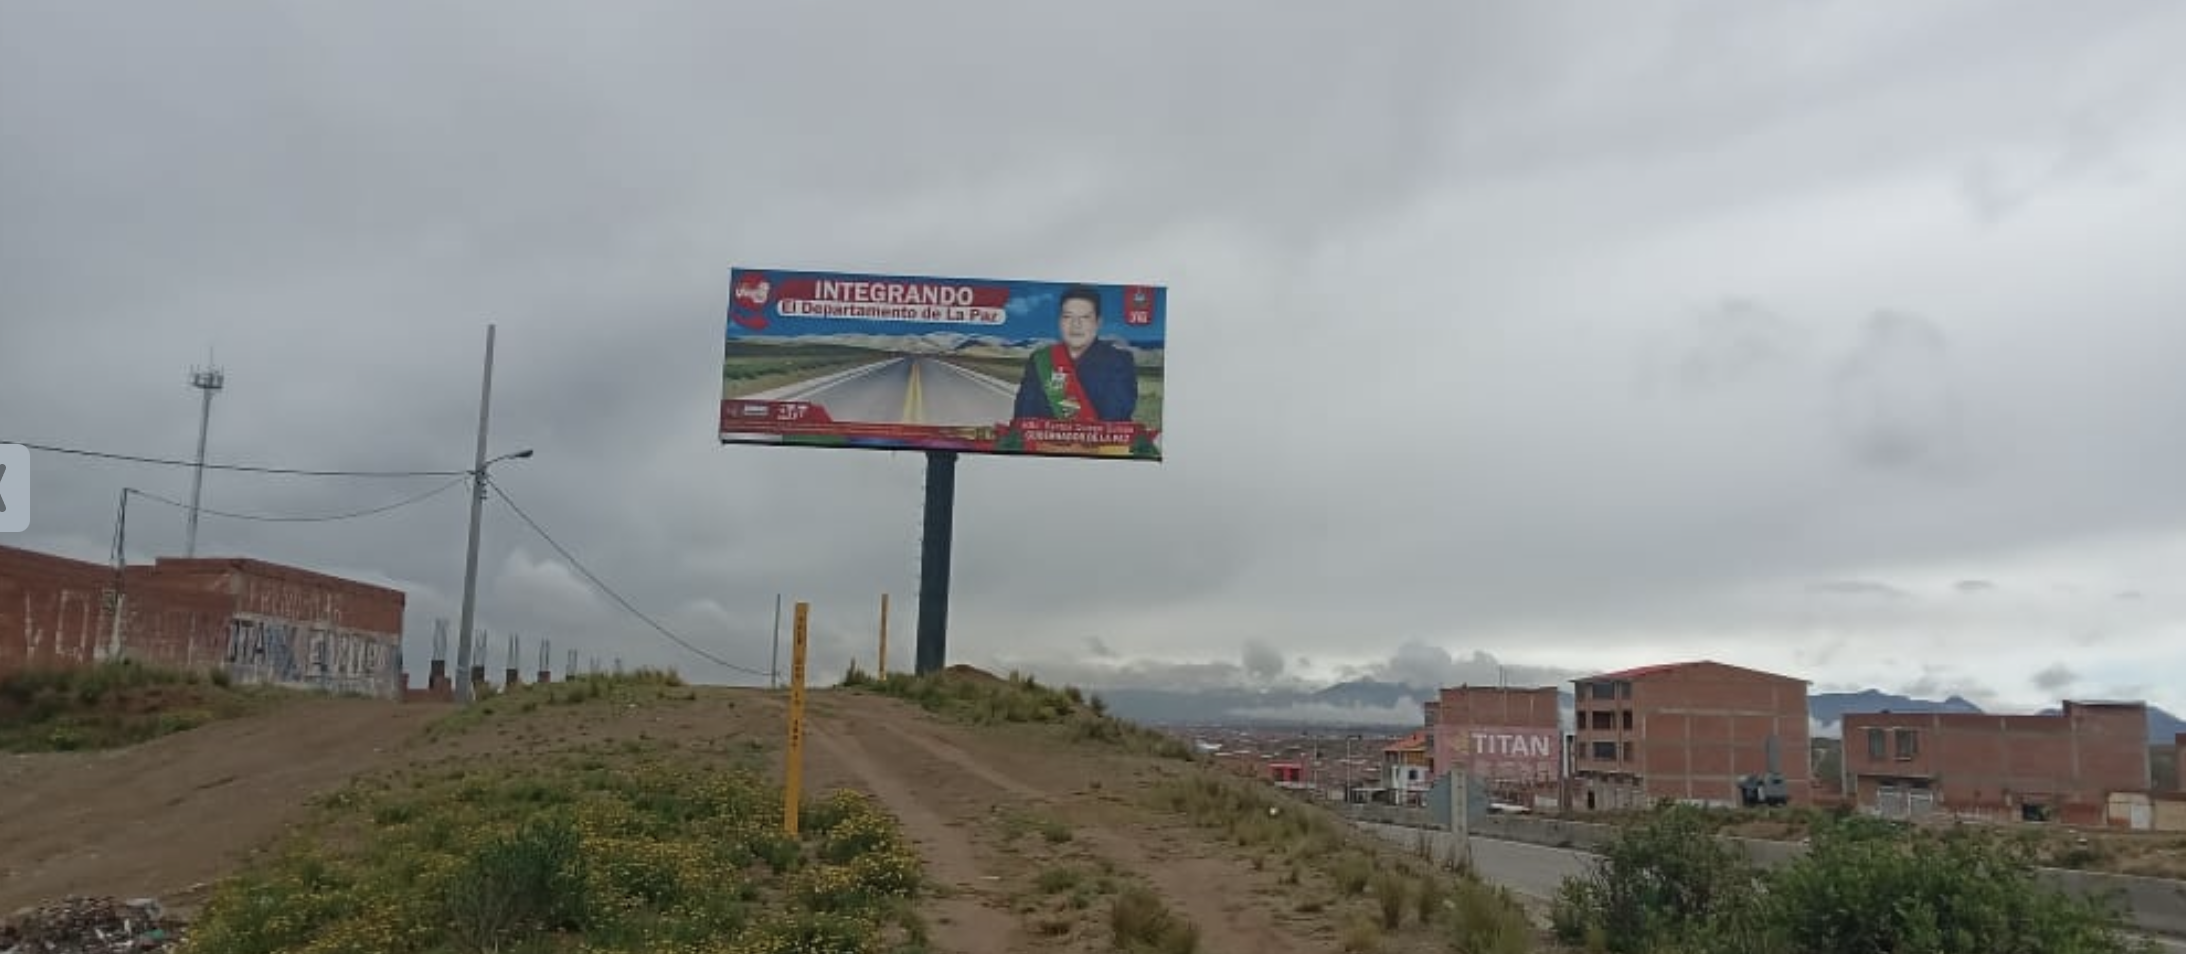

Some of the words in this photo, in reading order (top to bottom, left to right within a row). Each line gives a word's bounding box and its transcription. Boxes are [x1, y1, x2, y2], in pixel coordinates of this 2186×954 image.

[815, 280, 974, 307] INTEGRANDO
[782, 300, 796, 312] El
[802, 302, 917, 322] Departamento
[921, 306, 941, 319] de
[948, 309, 965, 320] La
[970, 310, 1000, 323] Paz
[1470, 732, 1550, 757] TITAN
